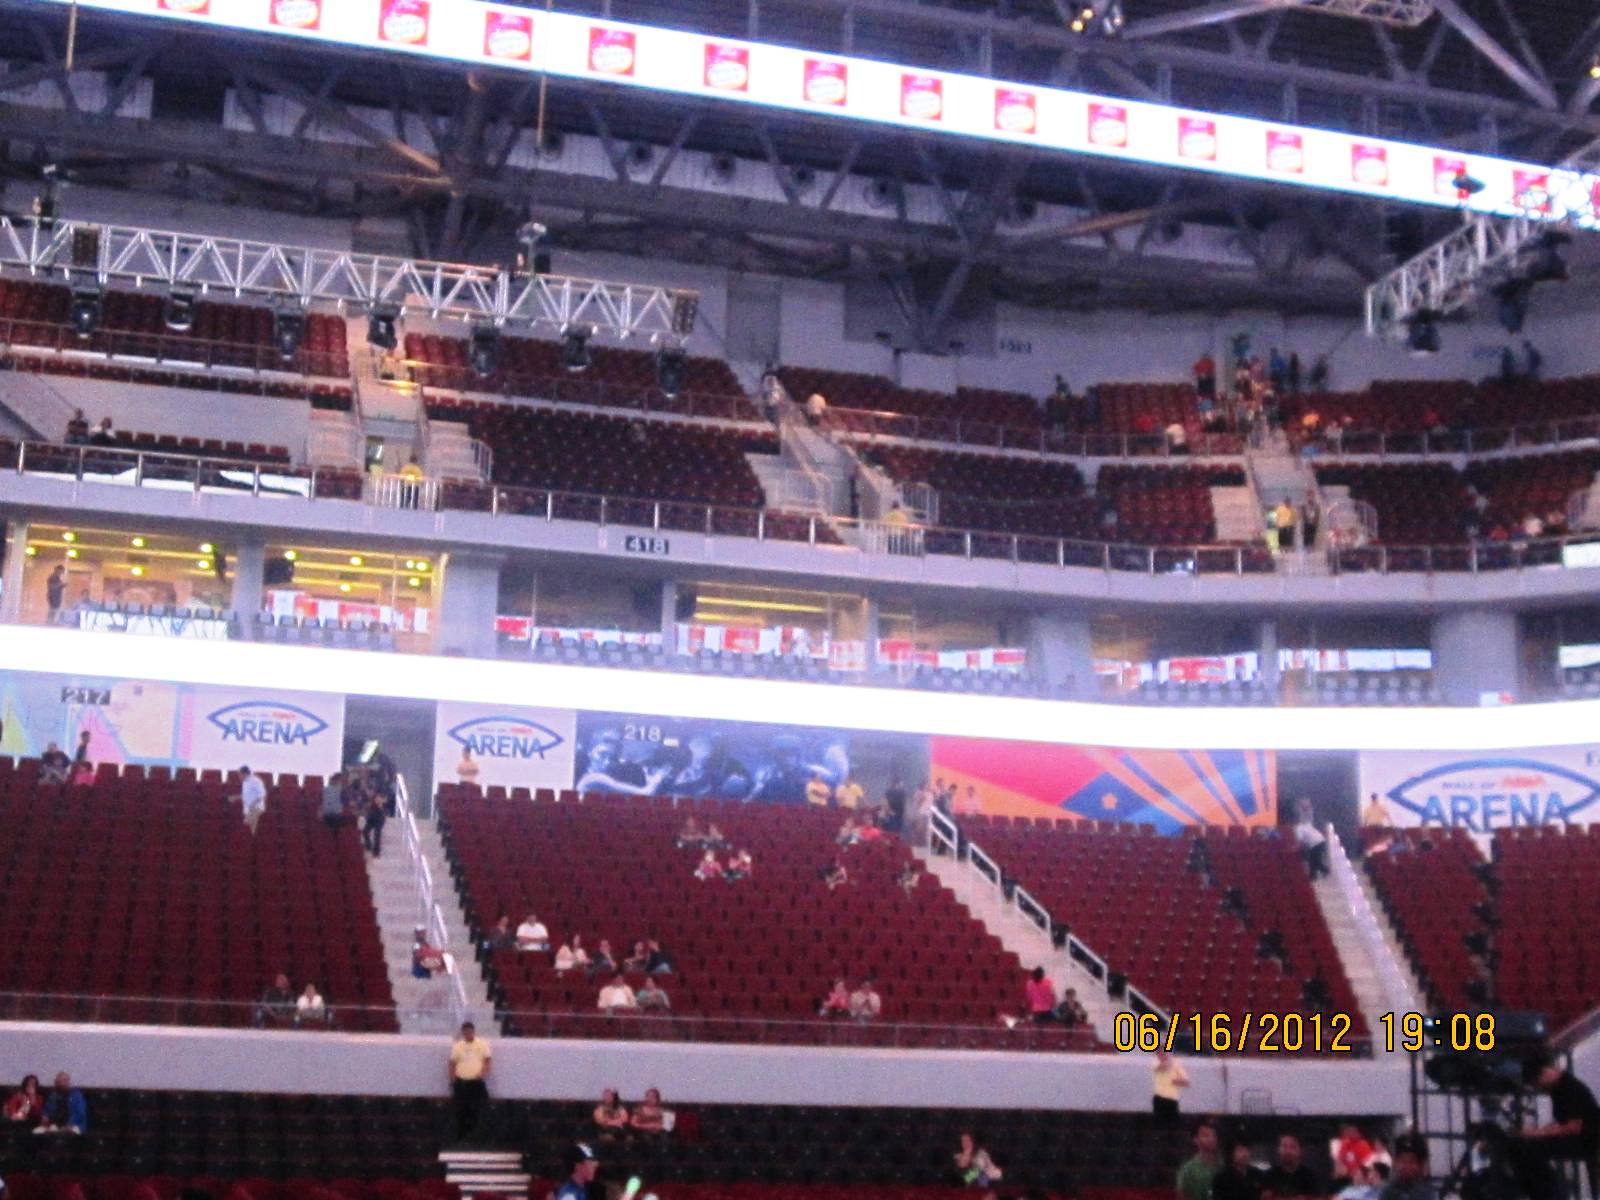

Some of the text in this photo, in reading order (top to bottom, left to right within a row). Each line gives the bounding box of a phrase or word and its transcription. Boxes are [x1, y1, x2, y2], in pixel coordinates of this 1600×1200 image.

[63, 686, 109, 705] 217
[222, 718, 308, 746] ARENA
[623, 722, 661, 742] 218
[464, 733, 545, 760] ARENA
[1421, 792, 1570, 832] ARENA
